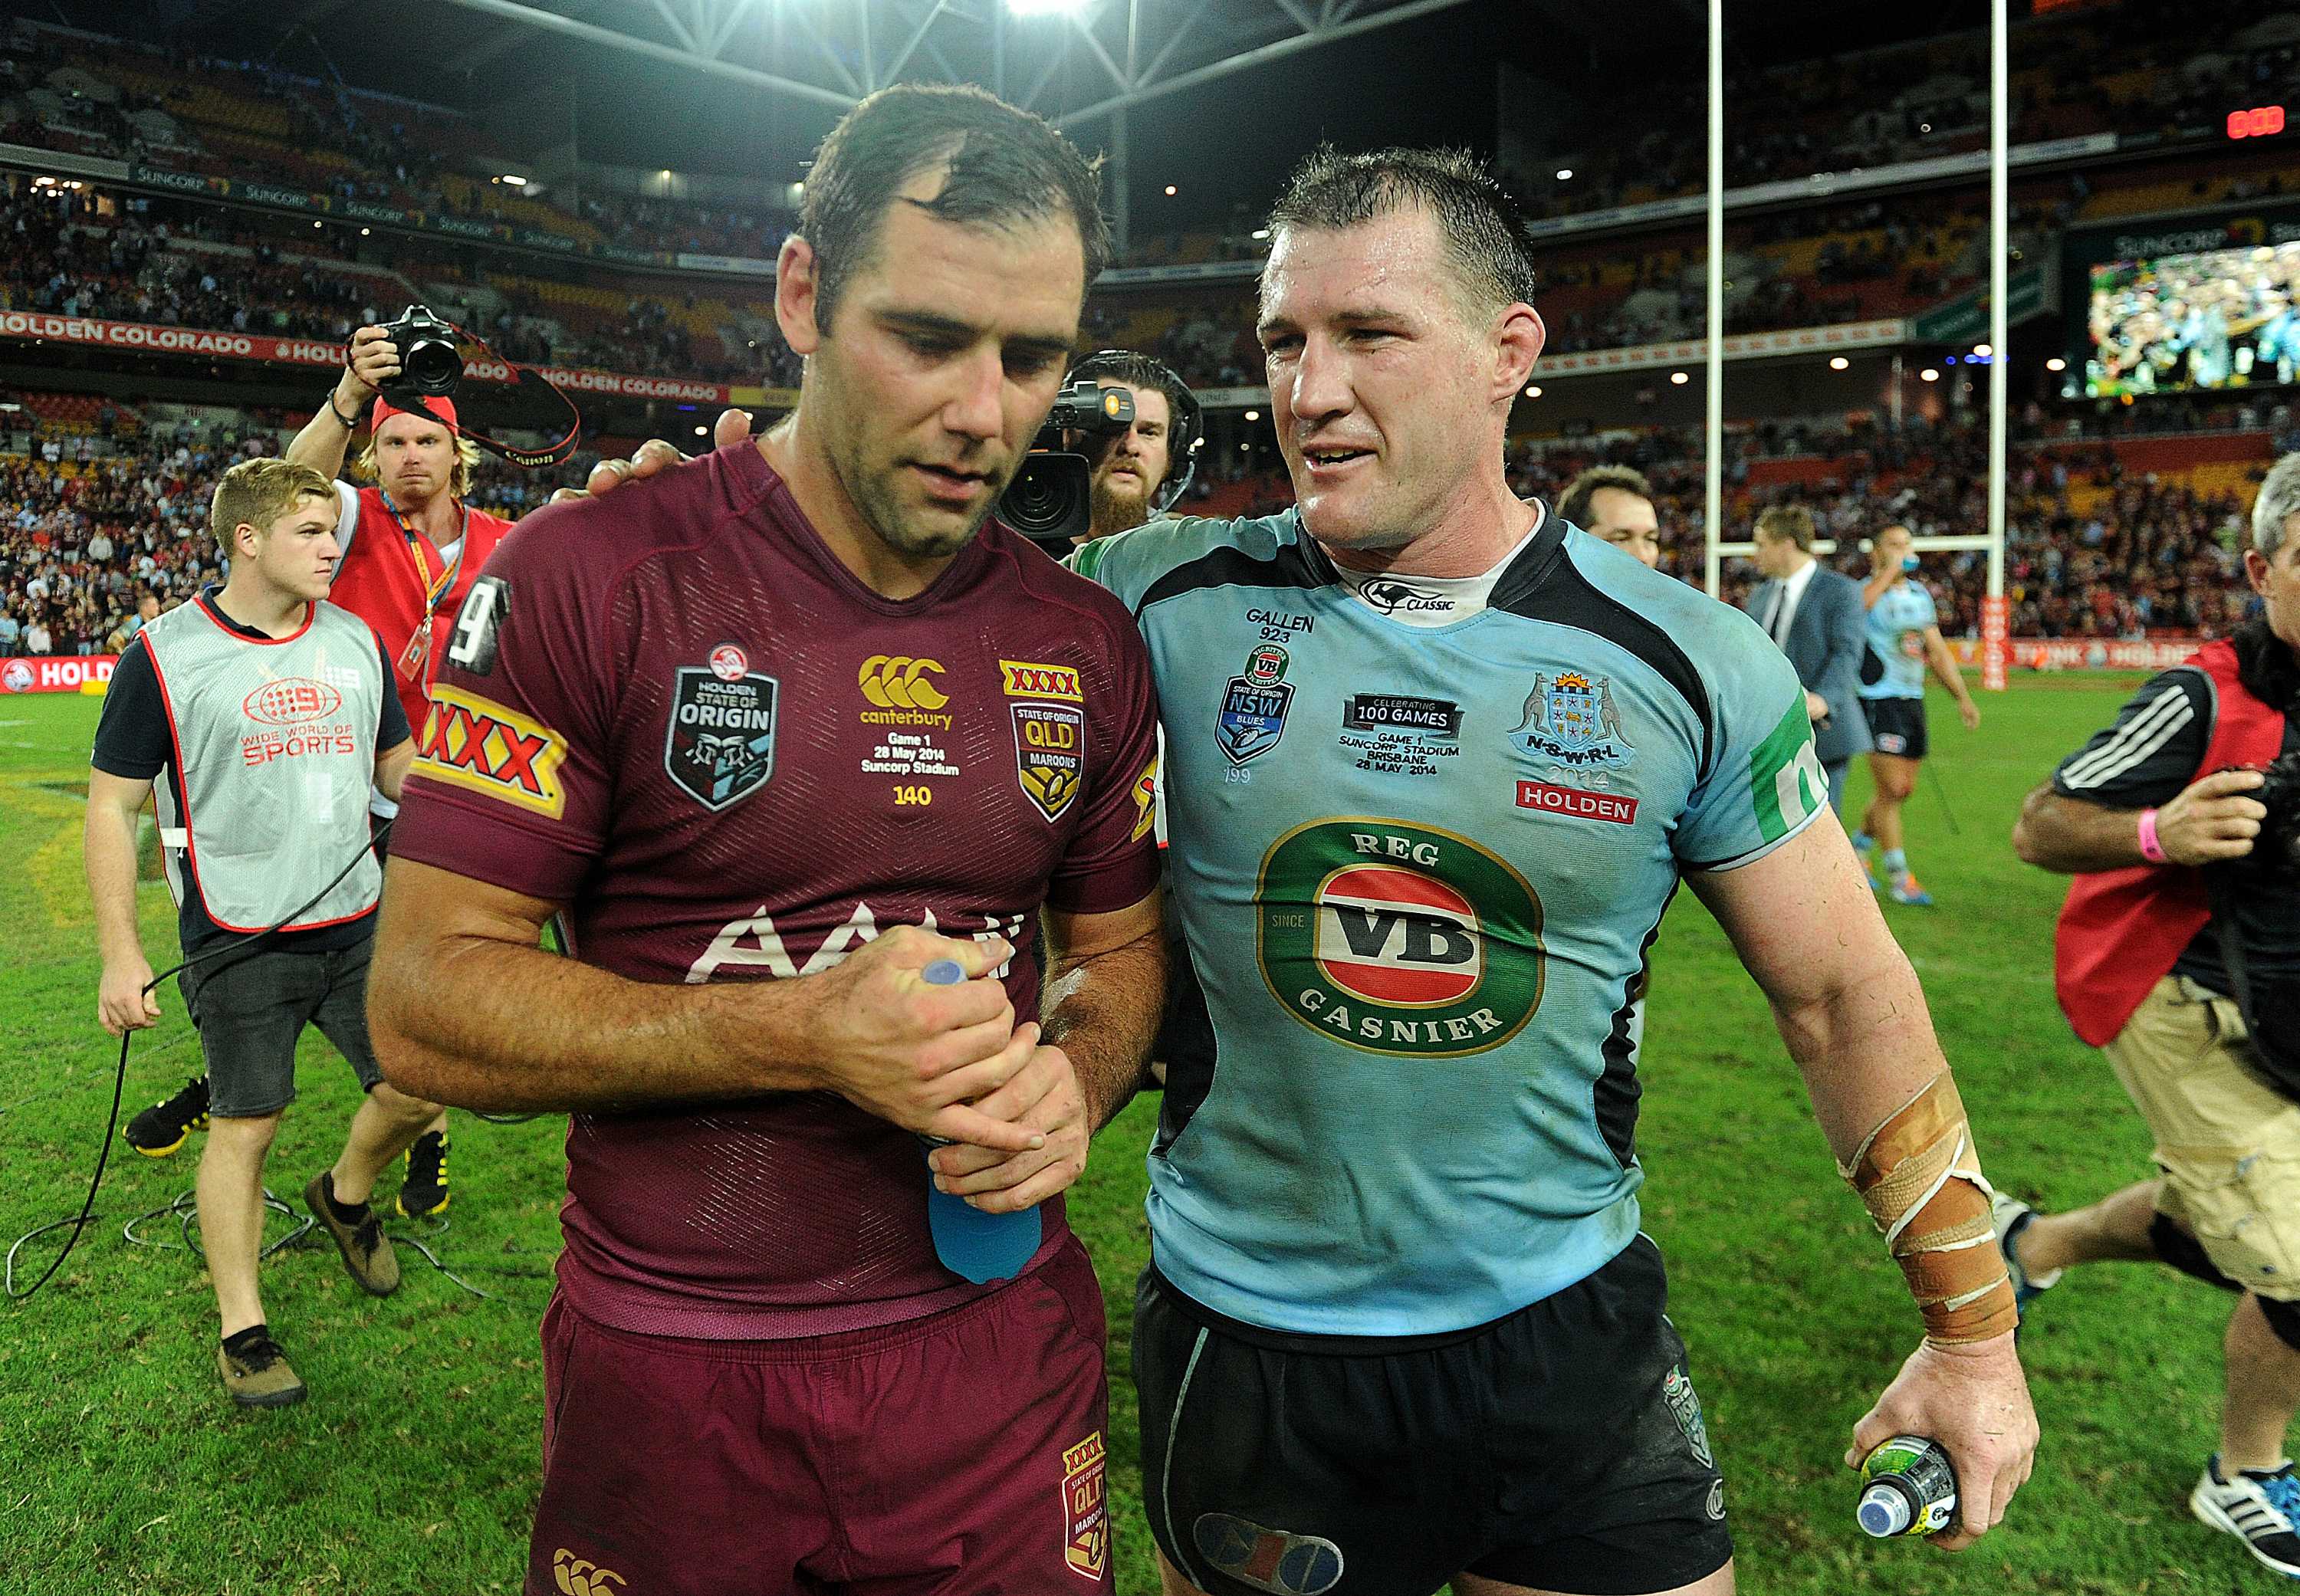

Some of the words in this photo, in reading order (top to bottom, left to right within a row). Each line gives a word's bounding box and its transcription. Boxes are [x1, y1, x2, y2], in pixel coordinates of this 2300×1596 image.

[0, 314, 104, 342] OLDEN
[109, 325, 251, 355] COLORADO
[1405, 599, 1456, 611] CLASSIC
[449, 581, 498, 665] 9
[1245, 608, 1316, 634] GALLEN
[1258, 626, 1291, 644] 923
[1257, 658, 1278, 673] VB
[698, 681, 757, 697] HOLDEN
[1008, 667, 1078, 695] XXXX
[695, 691, 739, 707] STATE
[739, 696, 759, 708] OF
[1232, 685, 1251, 695] STATE
[1260, 688, 1283, 699] ORIGIN
[1229, 694, 1282, 717] NSW
[1373, 698, 1436, 711] CELEBRATING
[679, 703, 770, 731] ORIGIN
[859, 709, 953, 731] canterbury
[1017, 709, 1043, 720] STATE
[1043, 711, 1053, 721] OF
[1053, 713, 1079, 724] ORIGIN
[1237, 715, 1266, 727] BLUES
[1358, 705, 1388, 721] 100
[1392, 708, 1448, 727] GAMES
[241, 731, 280, 746] WIDE
[286, 724, 329, 737] WORLD
[334, 724, 353, 734] OF
[887, 732, 922, 746] Game
[923, 734, 932, 747] 1
[1025, 721, 1075, 749] QLD
[1378, 732, 1414, 745] GAME
[243, 736, 355, 766] SPORTS
[873, 746, 891, 759] 28
[892, 746, 917, 762] May
[918, 748, 945, 761] 2014
[1339, 736, 1398, 752] SUNCORP
[1403, 744, 1460, 757] STADIUM
[1030, 753, 1076, 768] MAROONS
[1355, 758, 1371, 770] 28
[1375, 761, 1403, 773] MAY
[1409, 765, 1438, 776] 2014
[1366, 750, 1428, 765] BRISBANE
[861, 760, 911, 776] Suncorp
[912, 761, 960, 776] Stadium
[1546, 766, 1609, 787] 2014
[893, 786, 932, 806] 140
[1524, 787, 1630, 819] HOLDEN
[1349, 833, 1440, 867] REG
[1271, 915, 1304, 928] SINCE
[1322, 901, 1476, 965] VB
[1300, 988, 1503, 1043] GASNIER
[1067, 1437, 1101, 1471] XXXX
[1071, 1473, 1086, 1490] STATE
[1074, 1473, 1103, 1515] QLD
